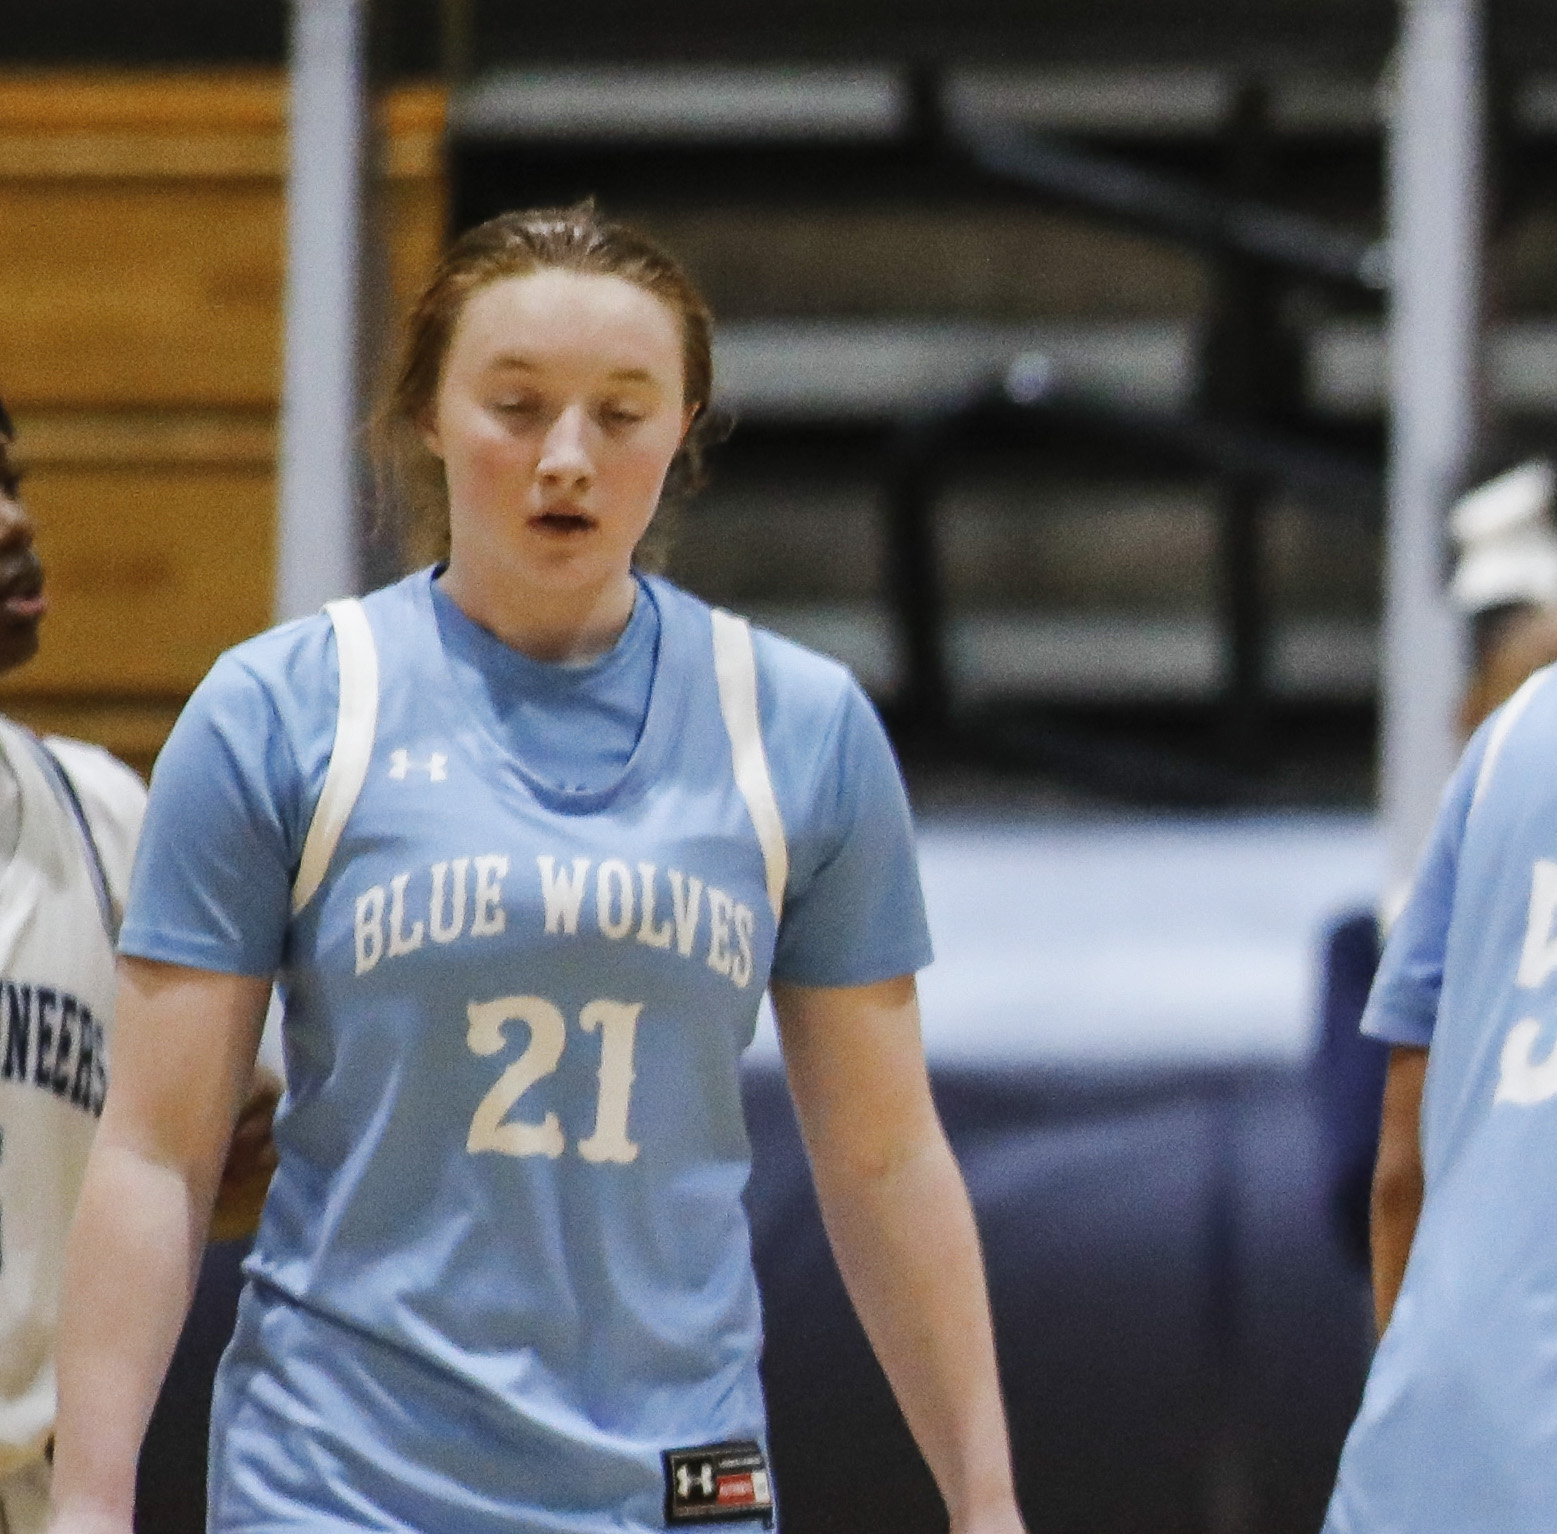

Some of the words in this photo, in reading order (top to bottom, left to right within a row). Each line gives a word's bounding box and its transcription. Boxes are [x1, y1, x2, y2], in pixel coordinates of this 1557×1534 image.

[353, 855, 508, 977] BLUE
[538, 855, 756, 989] WOLVES
[0, 980, 107, 1118] NEERS
[466, 996, 643, 1165] 21
